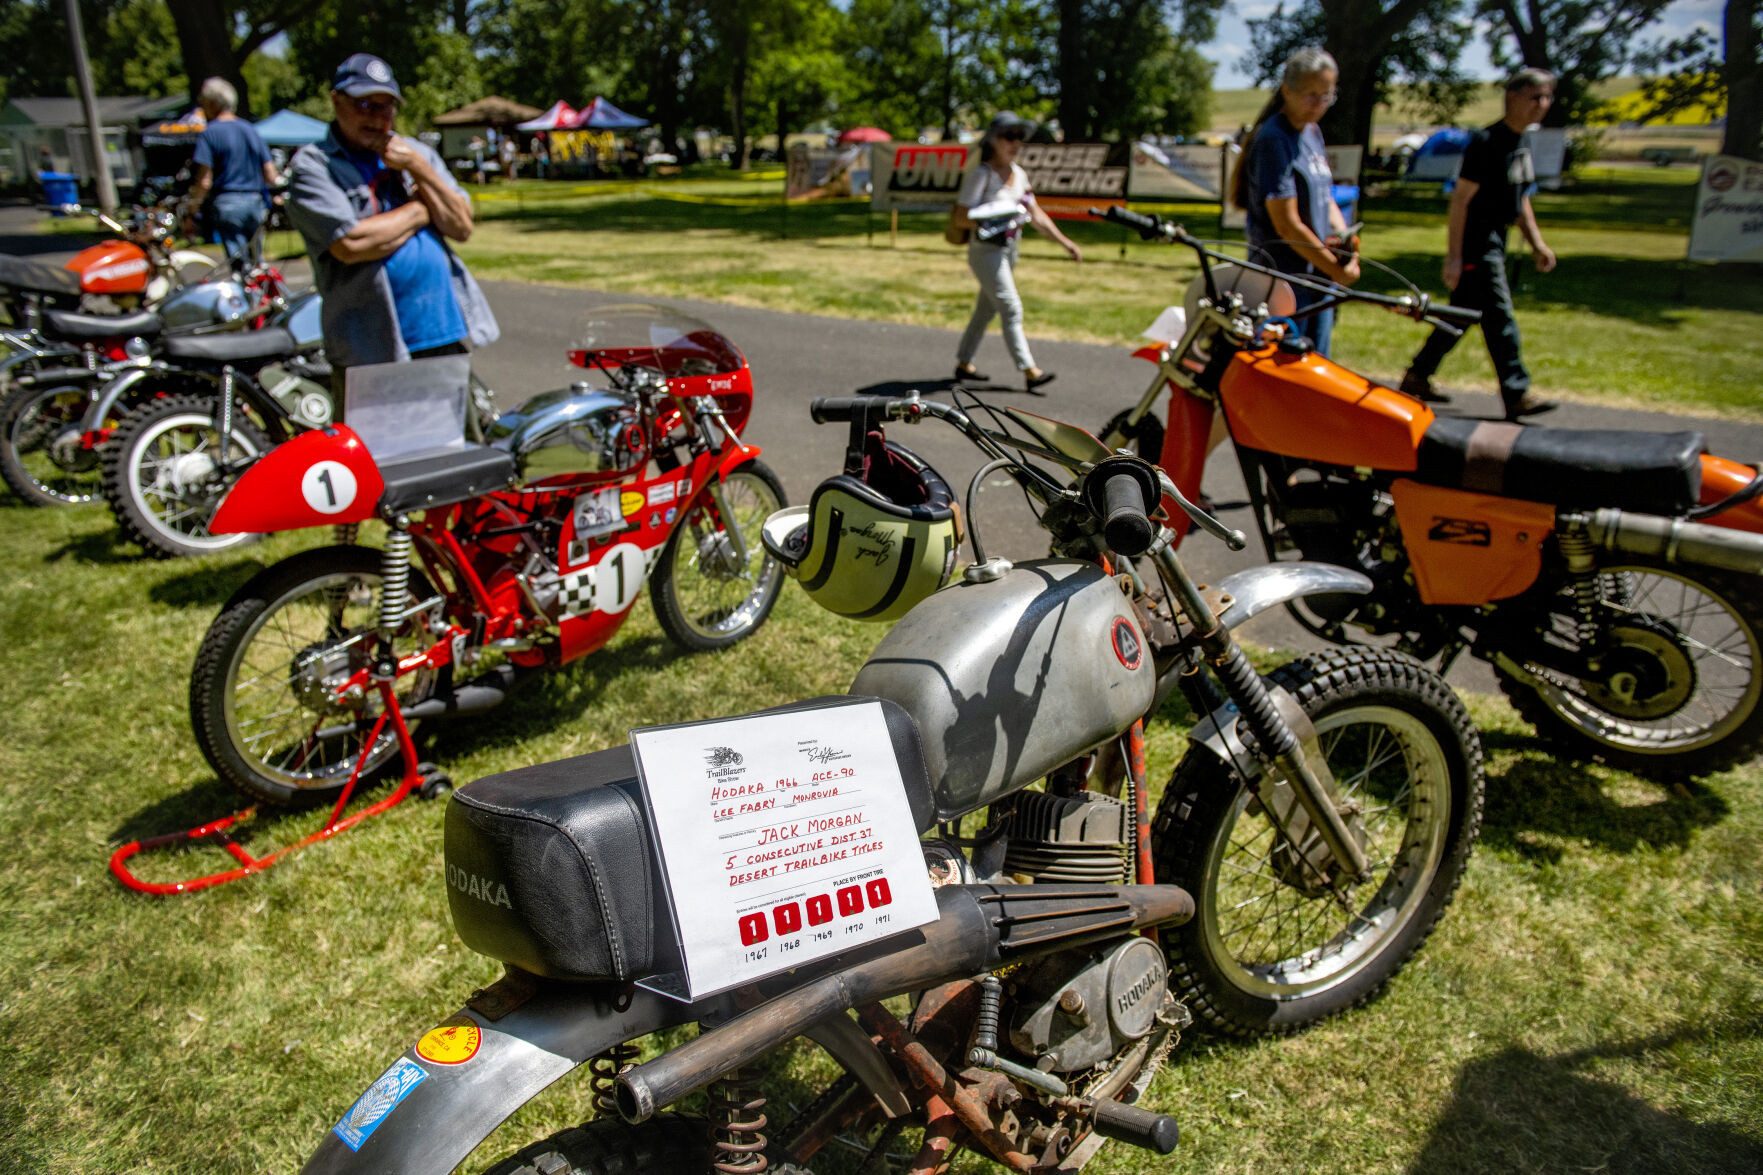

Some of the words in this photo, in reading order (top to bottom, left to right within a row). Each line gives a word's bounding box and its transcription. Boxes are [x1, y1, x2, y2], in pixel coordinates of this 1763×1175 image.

[891, 148, 966, 190] UNI
[318, 469, 336, 506] 1
[611, 552, 624, 605] 1
[706, 767, 746, 779] TrailBlazers
[711, 782, 764, 800] HODAKA
[776, 777, 798, 788] 1966
[812, 768, 854, 782] ACE-90
[714, 807, 735, 818] LEE
[740, 798, 775, 813] FABRY
[793, 787, 838, 803] MONROVIA
[758, 824, 799, 845] JACK
[808, 812, 862, 833] MORGAN
[725, 855, 737, 870] 5
[747, 839, 823, 865] CONSECUTIVE
[831, 833, 857, 845] DIST.
[860, 828, 872, 839] 37
[729, 865, 778, 887] DESERT
[784, 850, 847, 872] TRAILBIKE
[852, 841, 883, 857] TITLES
[833, 877, 850, 887] PLACE
[850, 875, 857, 883] BY
[857, 872, 873, 881] FRONT
[873, 868, 884, 876] TIRE
[749, 919, 757, 937] 1
[783, 909, 791, 925] 1
[815, 901, 822, 916] 1
[847, 892, 854, 907] 1
[874, 885, 882, 900] 1
[745, 947, 767, 963] 1967
[780, 939, 800, 952] 1968
[814, 930, 833, 942] 1969
[845, 923, 863, 934] 1970
[875, 913, 890, 924] 1971
[1118, 964, 1161, 1014] HODAKA
[463, 1026, 478, 1053] CYCLE
